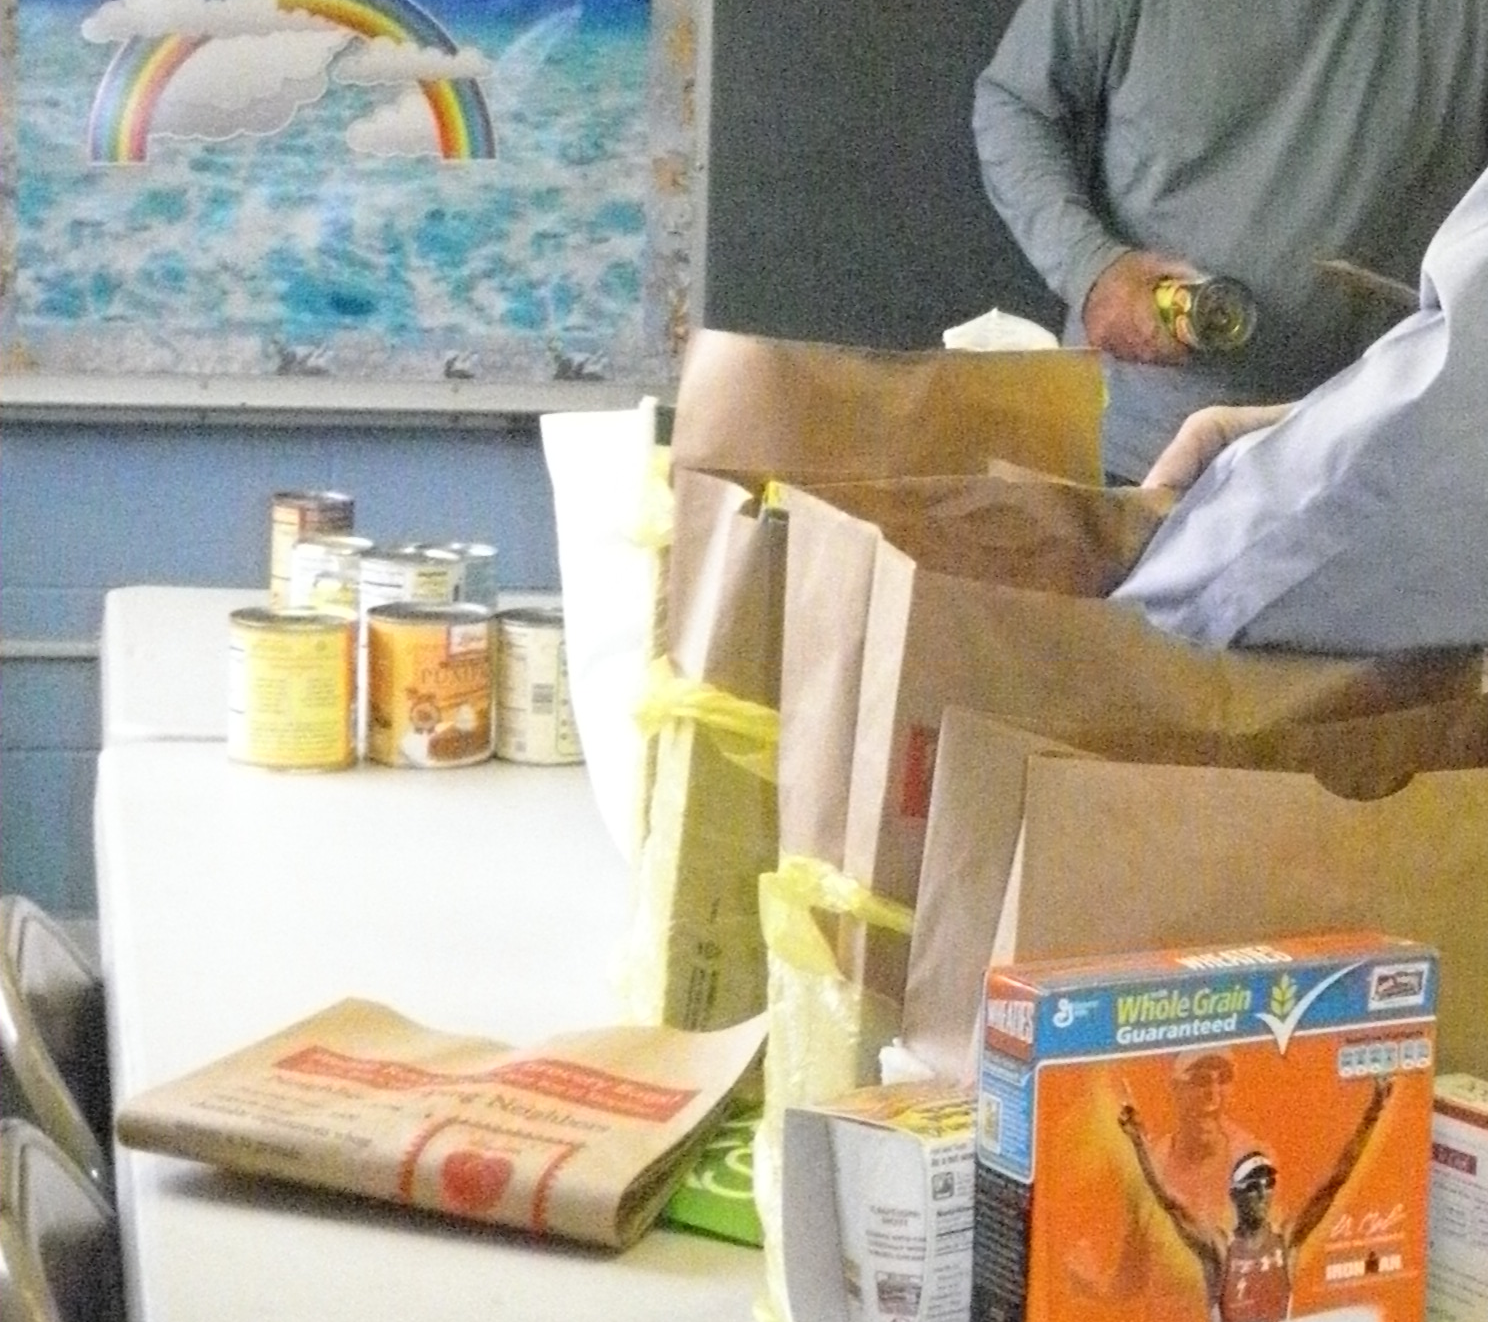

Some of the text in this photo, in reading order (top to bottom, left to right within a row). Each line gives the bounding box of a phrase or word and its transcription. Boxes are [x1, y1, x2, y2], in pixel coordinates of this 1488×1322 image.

[1116, 990, 1189, 1024] Whole
[1192, 984, 1251, 1015] Grain
[1116, 1014, 1238, 1045] Guaranteed
